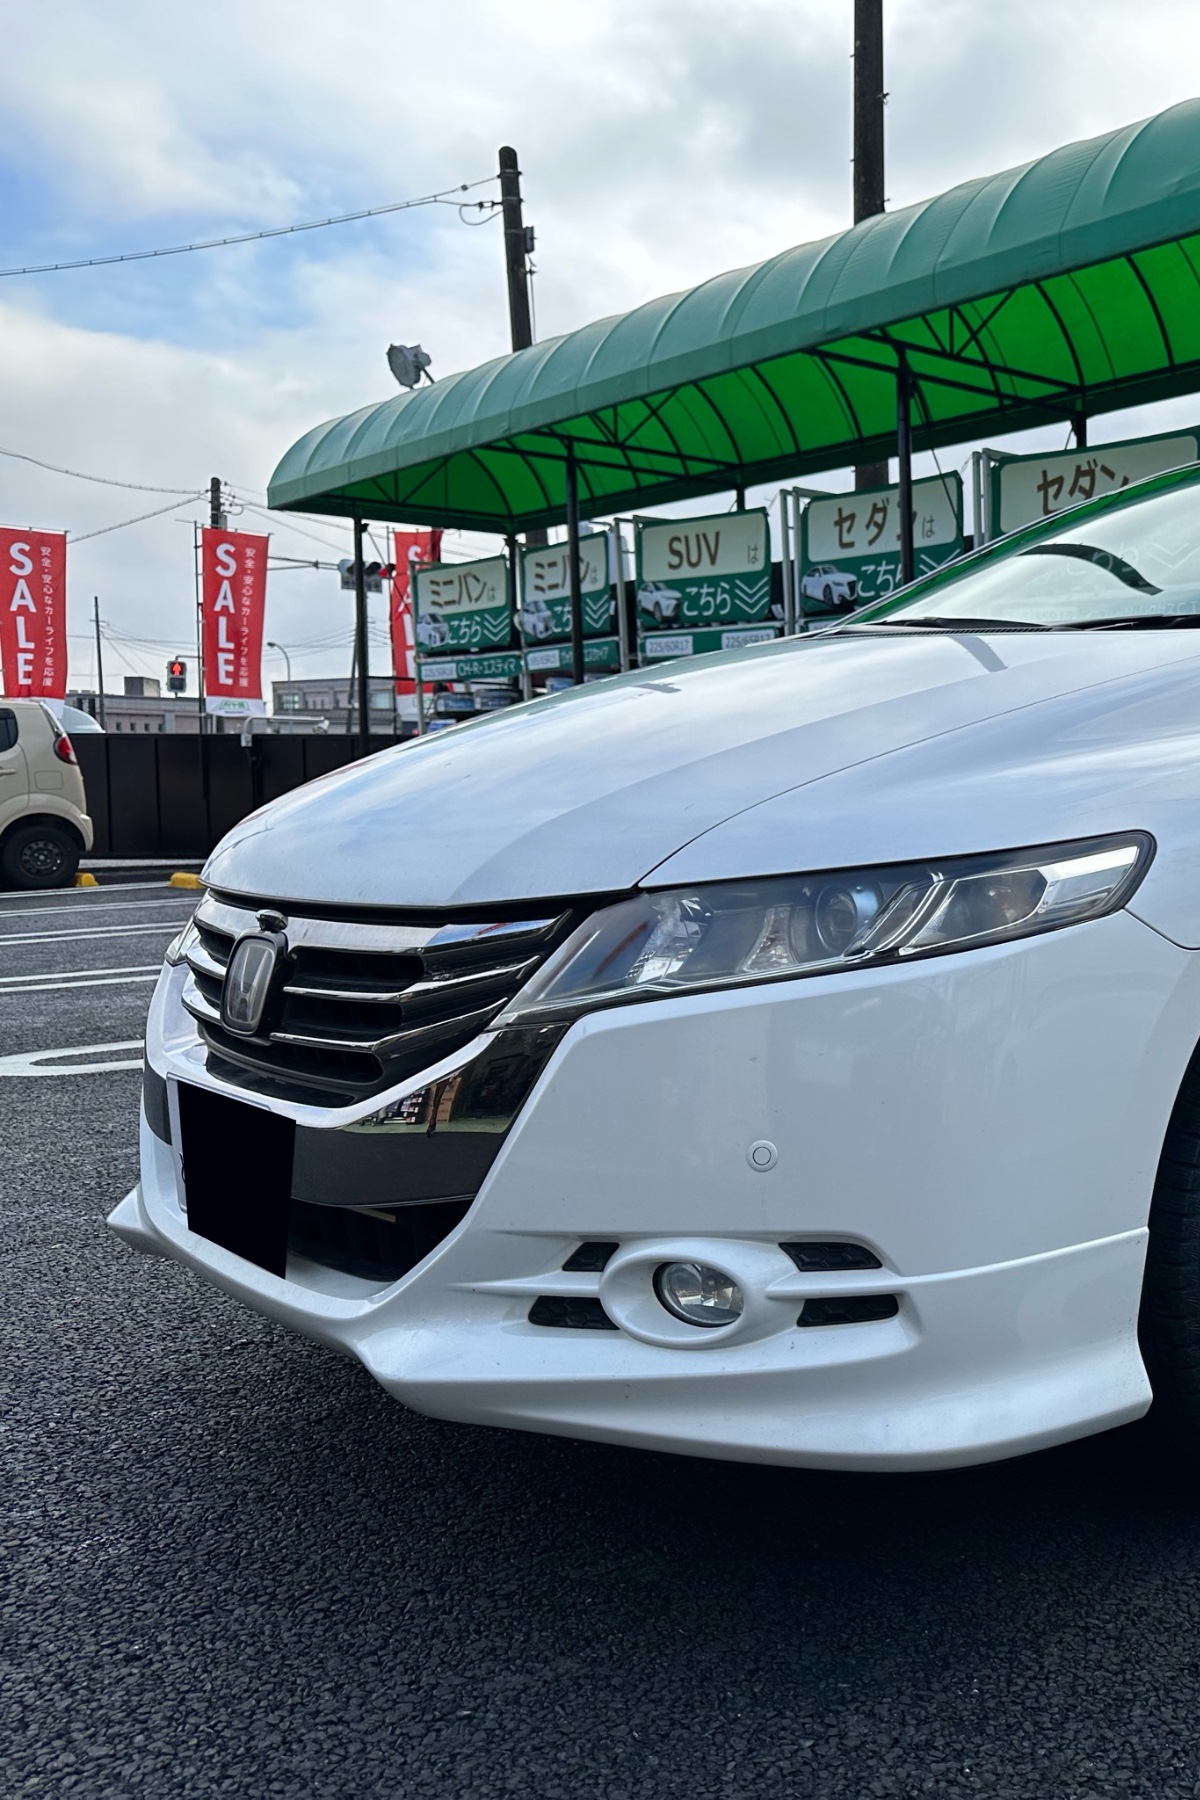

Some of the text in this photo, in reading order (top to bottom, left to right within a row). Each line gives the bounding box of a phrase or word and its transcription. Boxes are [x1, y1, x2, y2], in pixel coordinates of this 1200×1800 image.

[833, 497, 936, 549] セダは
[667, 530, 759, 570] SUV は
[429, 571, 496, 609] ミニバンは
[683, 582, 731, 616] こちら
[9, 542, 37, 686] SALE
[40, 546, 55, 687] 安全・安心なカーライフを応援
[213, 542, 238, 686] SALE
[448, 615, 482, 645] こちら
